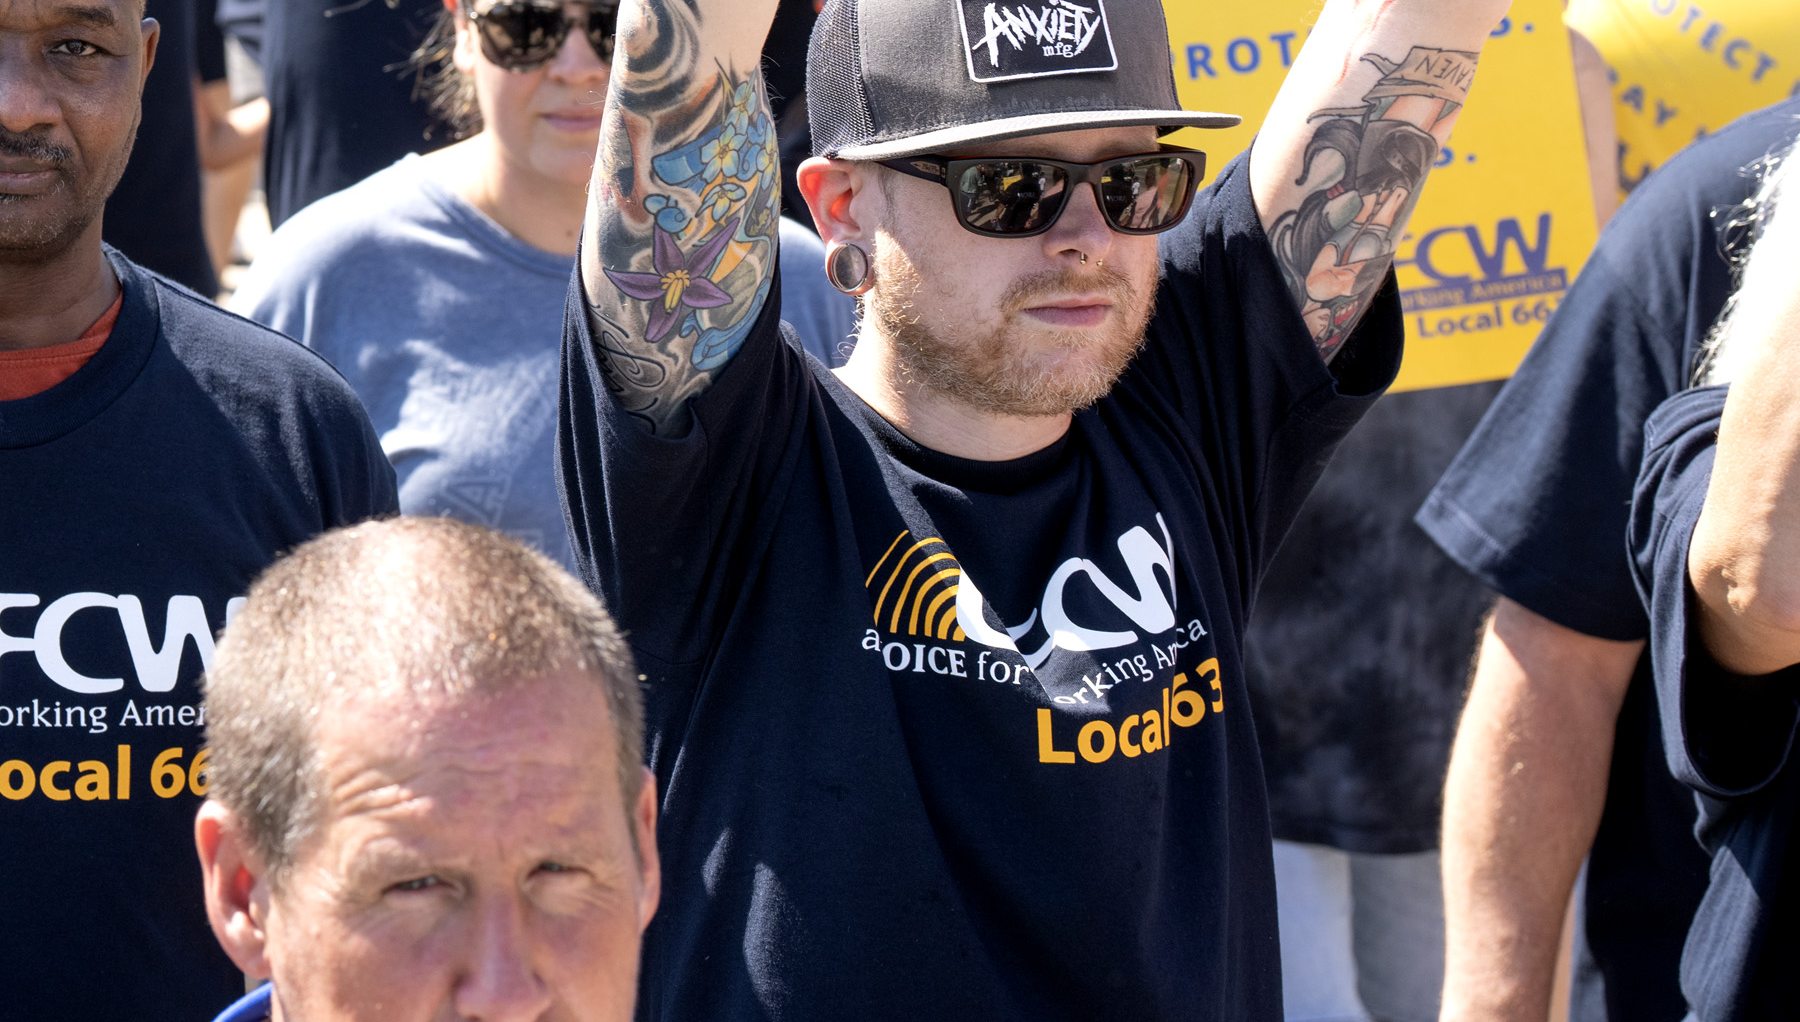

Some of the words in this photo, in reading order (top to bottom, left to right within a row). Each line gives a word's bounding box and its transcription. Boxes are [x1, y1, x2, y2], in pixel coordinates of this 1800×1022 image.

[1041, 42, 1074, 58] mfg
[1418, 301, 1503, 340] Local
[861, 628, 882, 652] a
[883, 643, 968, 678] OICE
[977, 651, 1036, 685] for
[1053, 654, 1154, 706] orking
[118, 699, 208, 726] Amer
[1037, 687, 1170, 764] Local
[150, 748, 212, 799] 66
